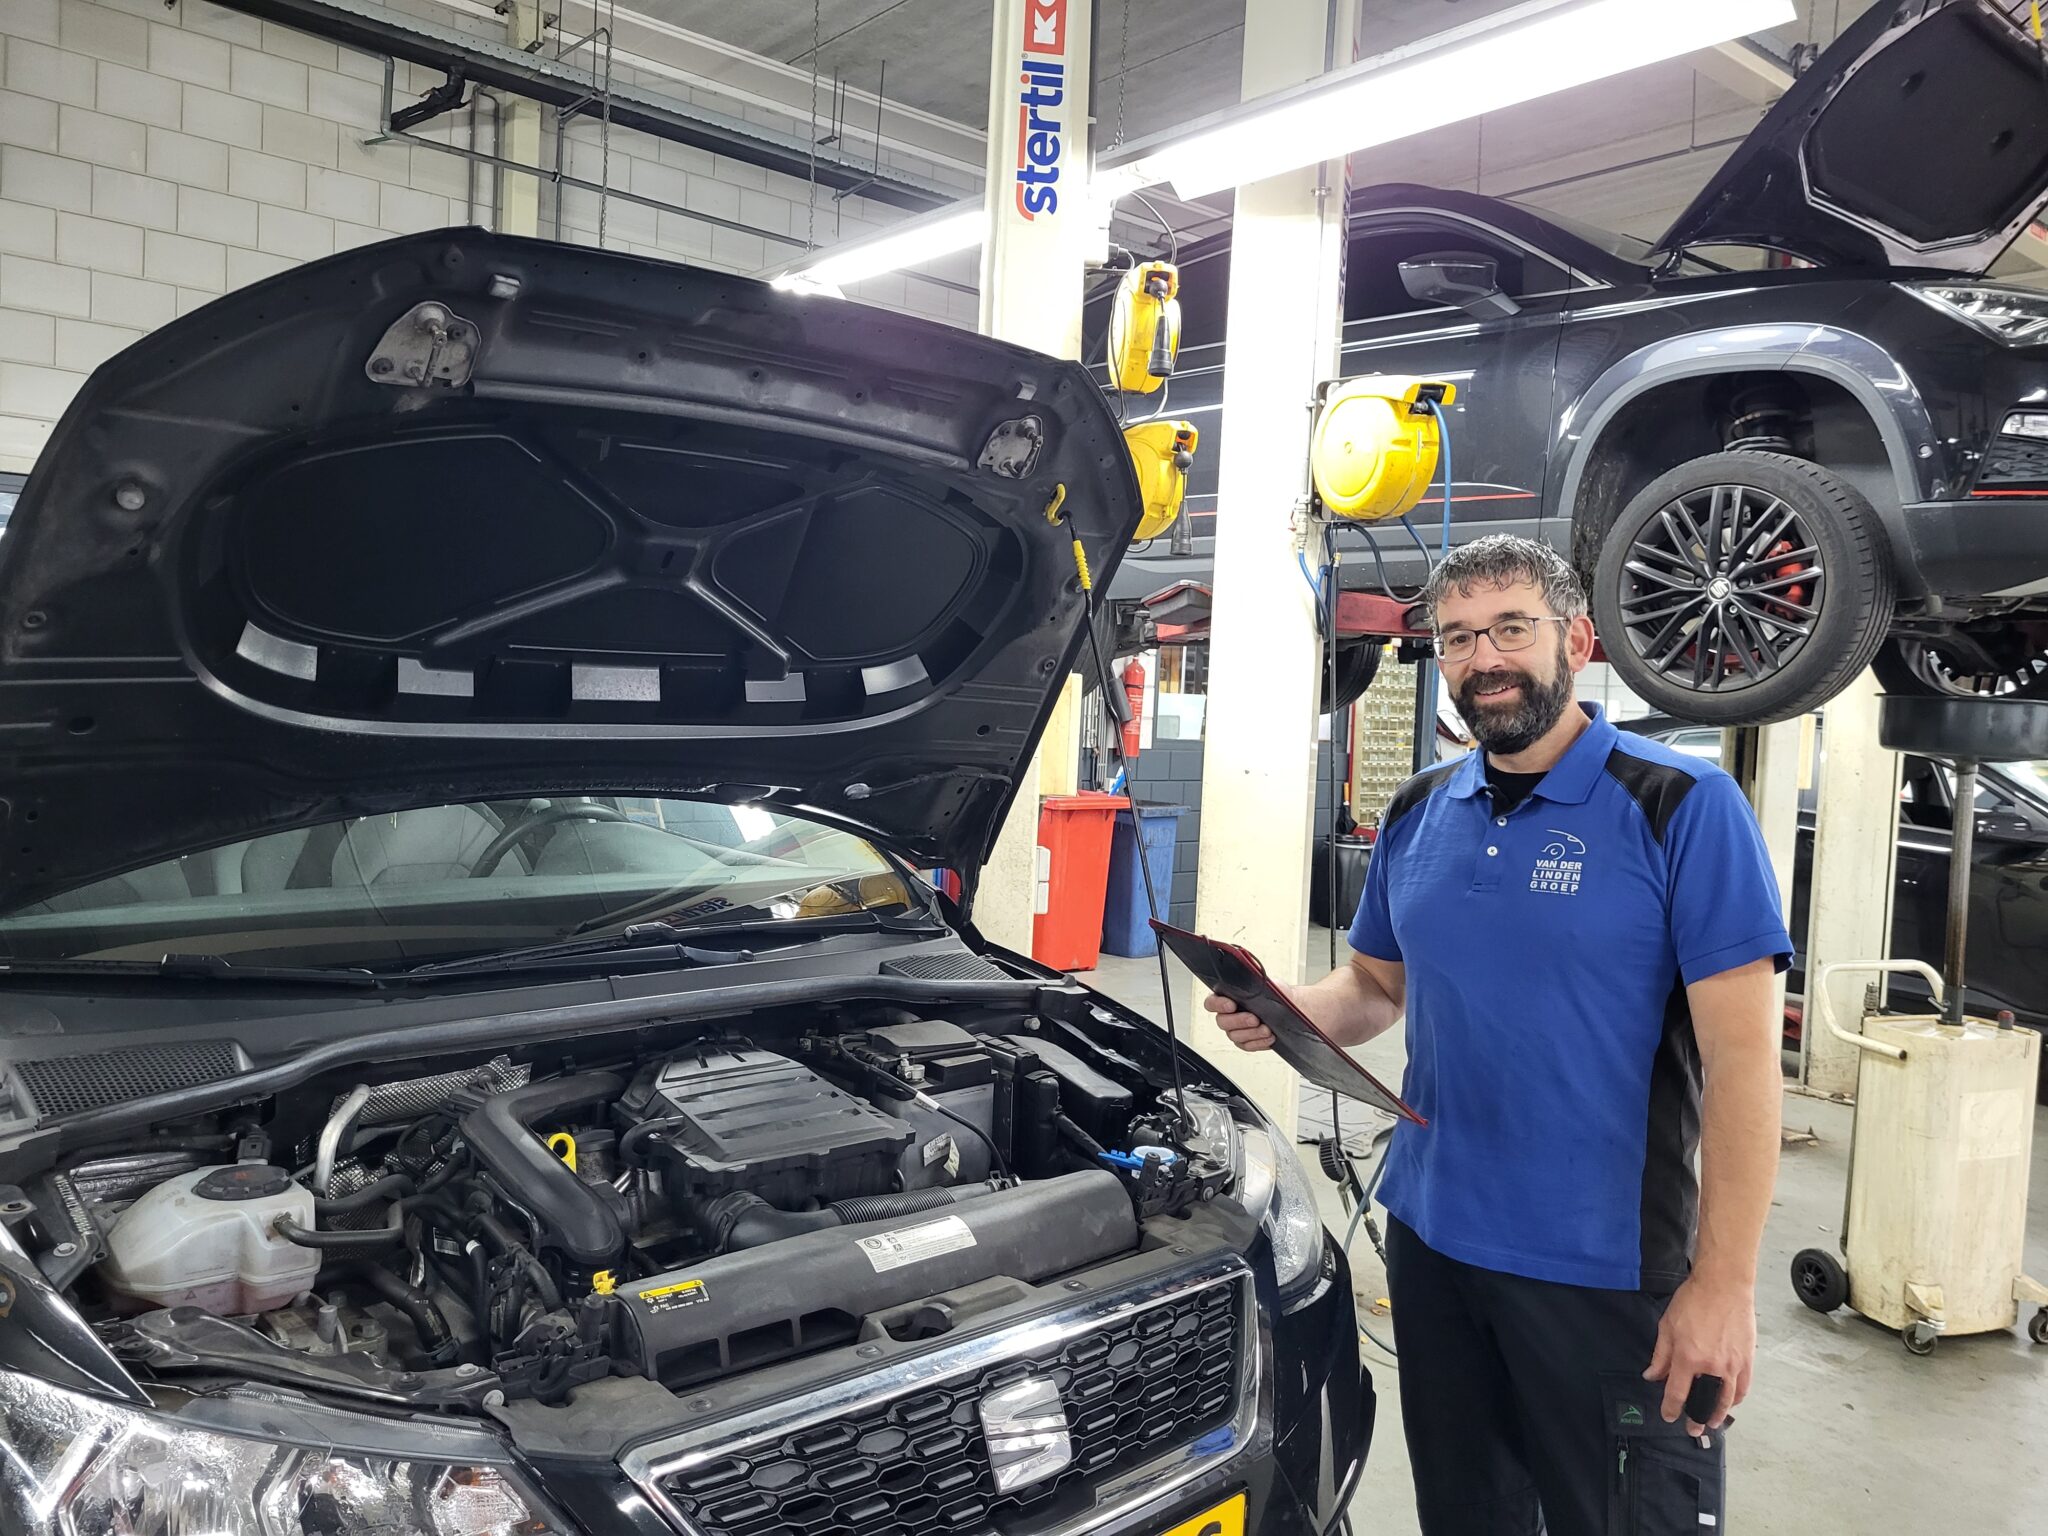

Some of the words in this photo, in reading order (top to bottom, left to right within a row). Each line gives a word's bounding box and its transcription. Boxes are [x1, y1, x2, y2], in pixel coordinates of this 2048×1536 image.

[1033, 0, 1057, 45] K
[1017, 61, 1064, 216] stertil
[1536, 859, 1557, 869] VAN
[1560, 861, 1582, 870] DER
[1532, 869, 1581, 881] LINDEN
[1530, 880, 1579, 893] GROEP
